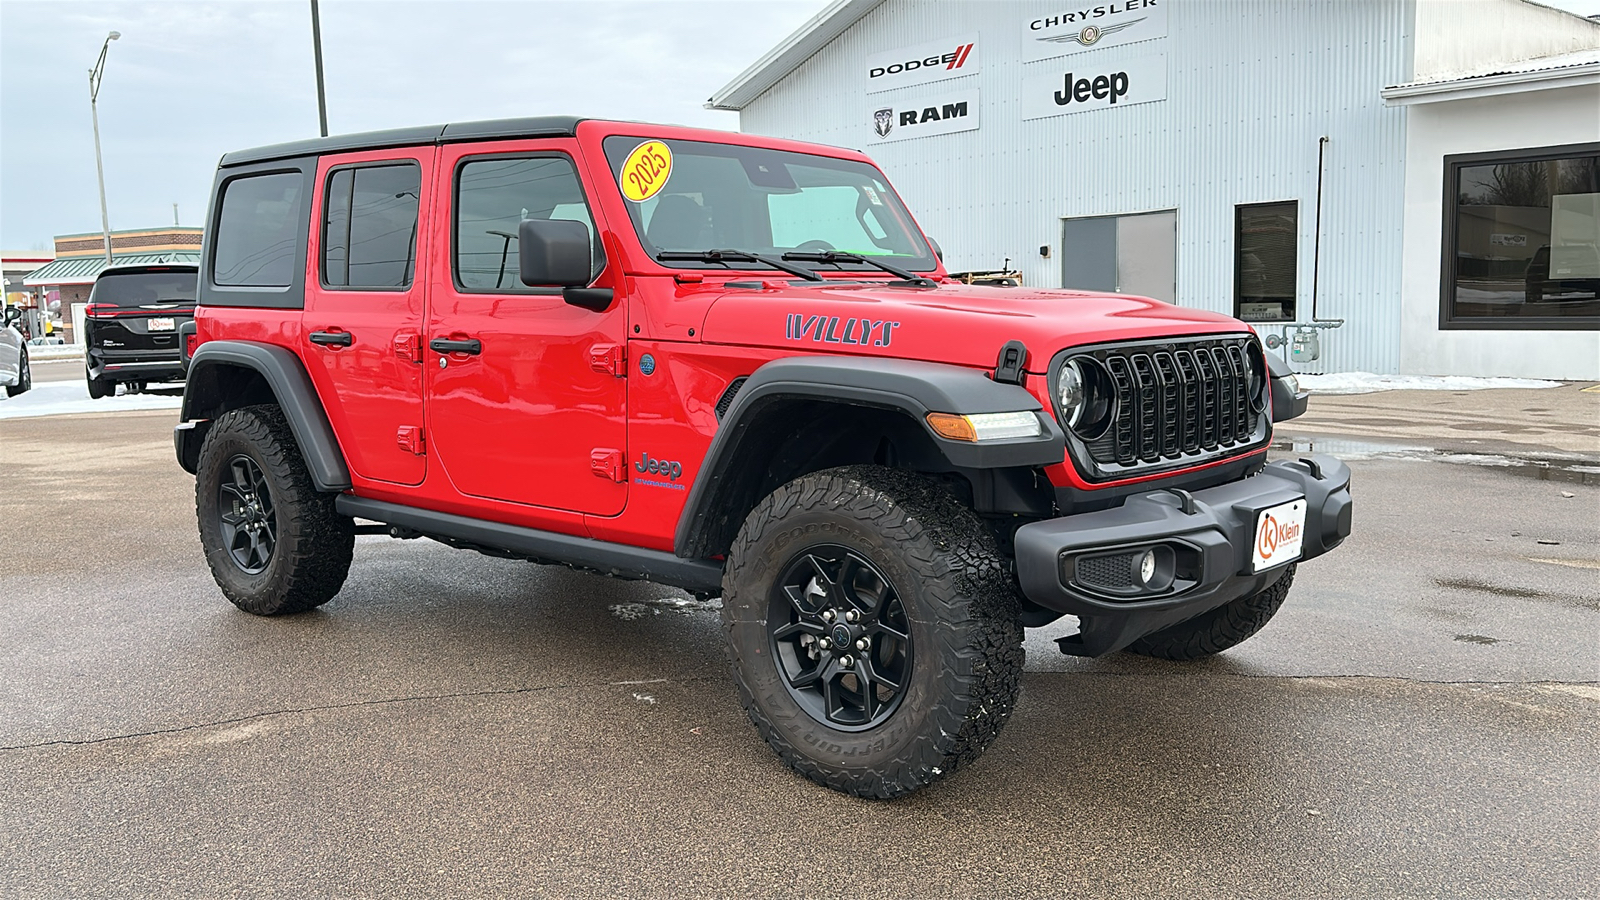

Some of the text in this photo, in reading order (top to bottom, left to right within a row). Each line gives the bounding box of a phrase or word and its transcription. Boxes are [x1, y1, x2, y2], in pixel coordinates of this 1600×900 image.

[1029, 0, 1157, 31] CHRYSLER
[869, 52, 958, 78] DODGE
[1053, 71, 1129, 106] Jeep
[899, 101, 968, 127] RAM
[628, 145, 667, 196] 2025
[786, 313, 901, 348] WILLYS
[635, 452, 682, 481] Jeep
[1278, 520, 1300, 543] Klein
